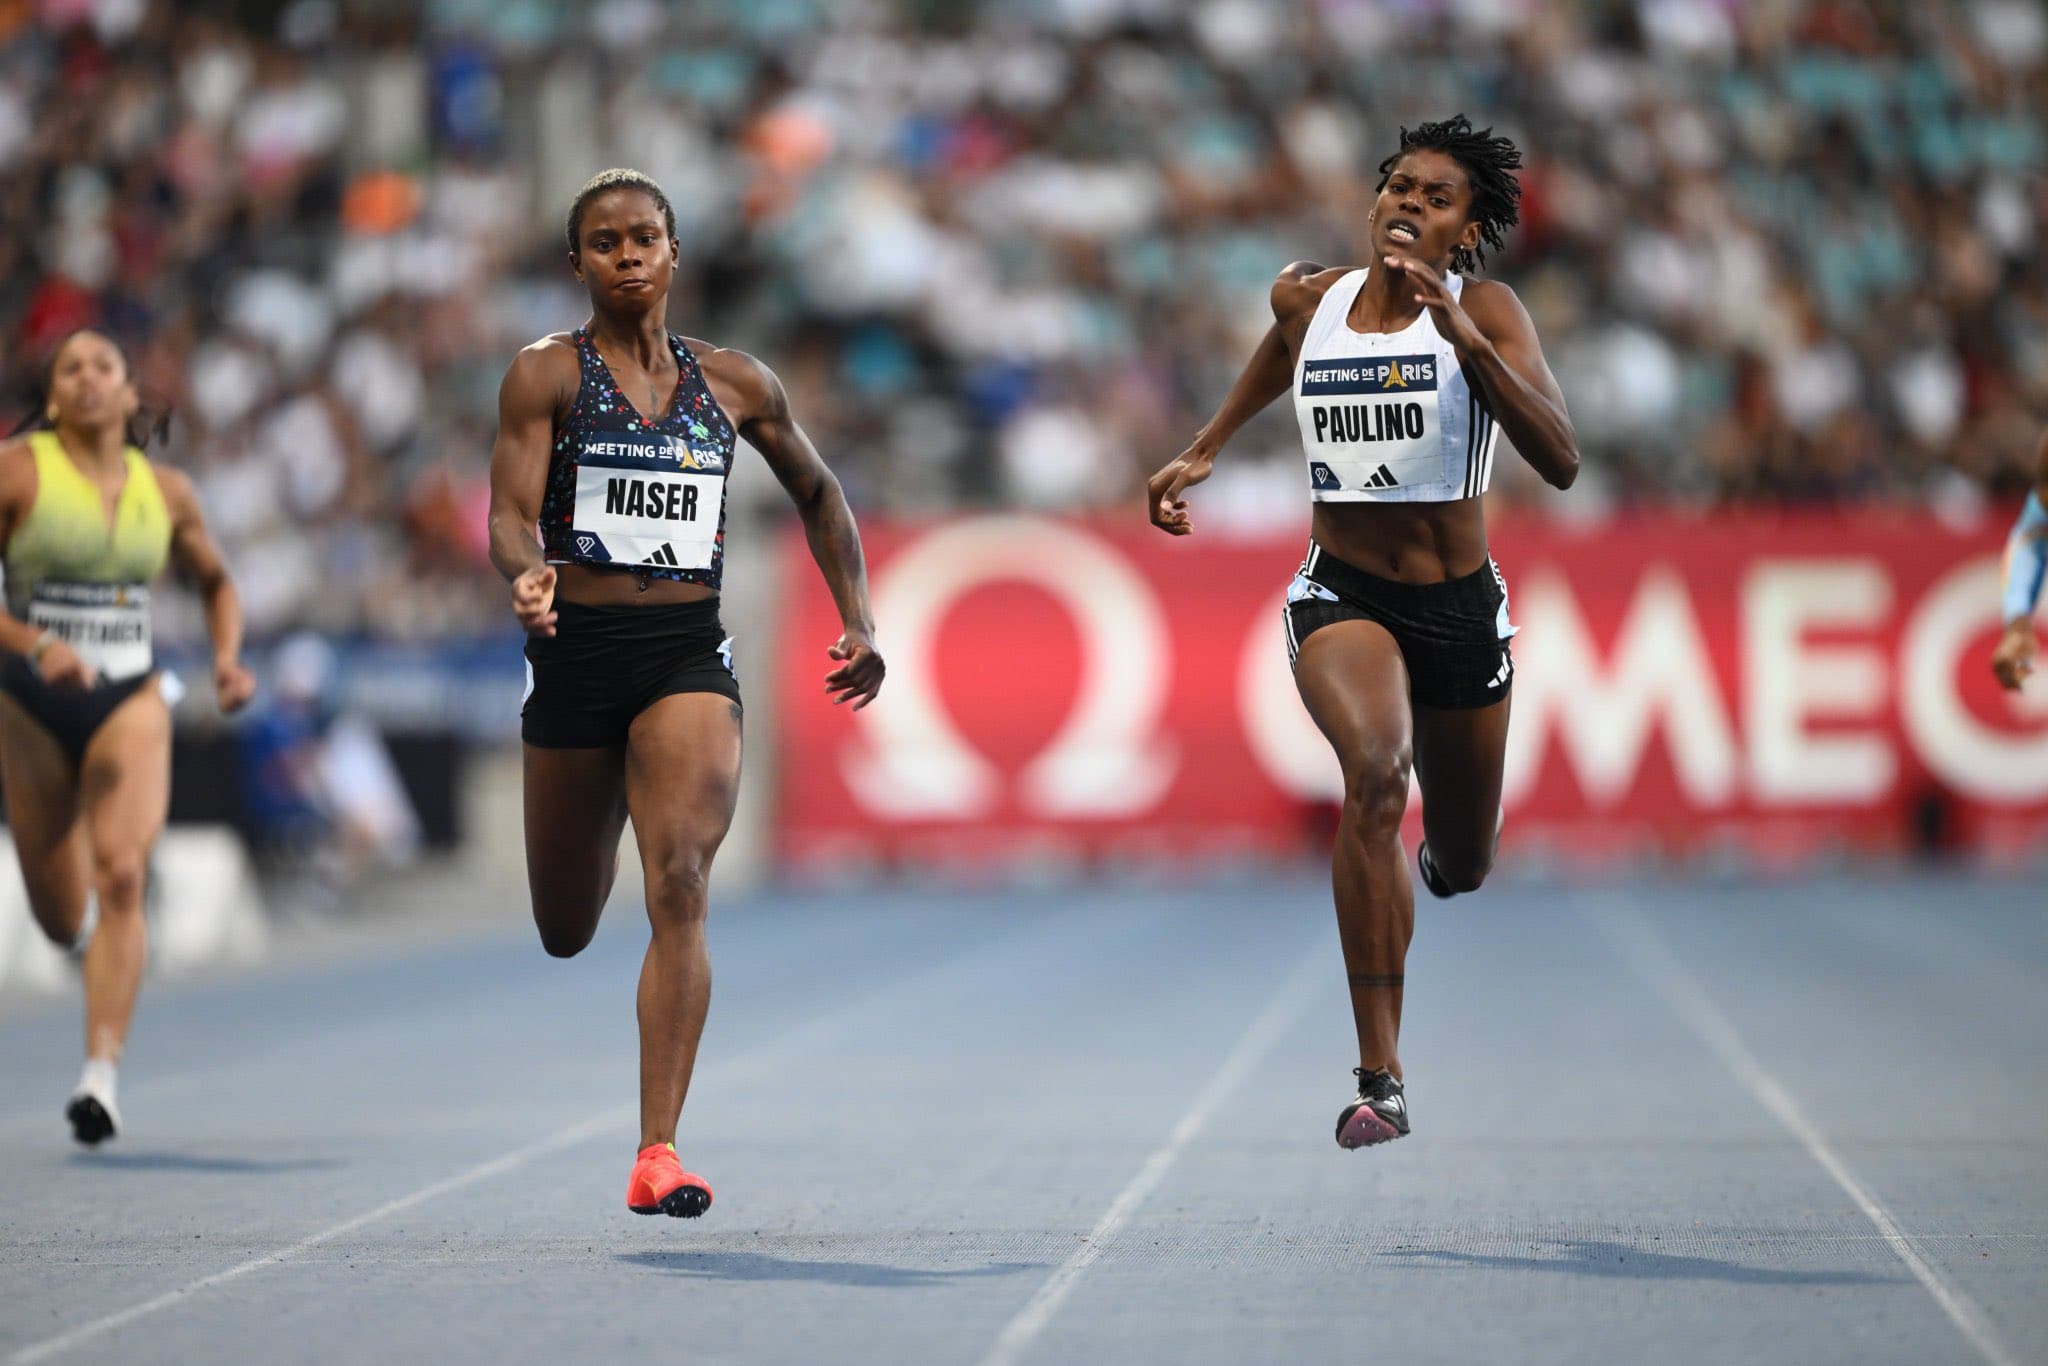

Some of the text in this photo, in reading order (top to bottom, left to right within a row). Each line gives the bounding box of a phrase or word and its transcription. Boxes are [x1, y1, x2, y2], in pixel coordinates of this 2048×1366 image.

[1305, 361, 1434, 387] MEETING DE PARIS
[1312, 402, 1424, 443] PAULINO
[584, 442, 656, 458] MEETING
[659, 446, 673, 458] DE
[606, 478, 698, 522] NASER
